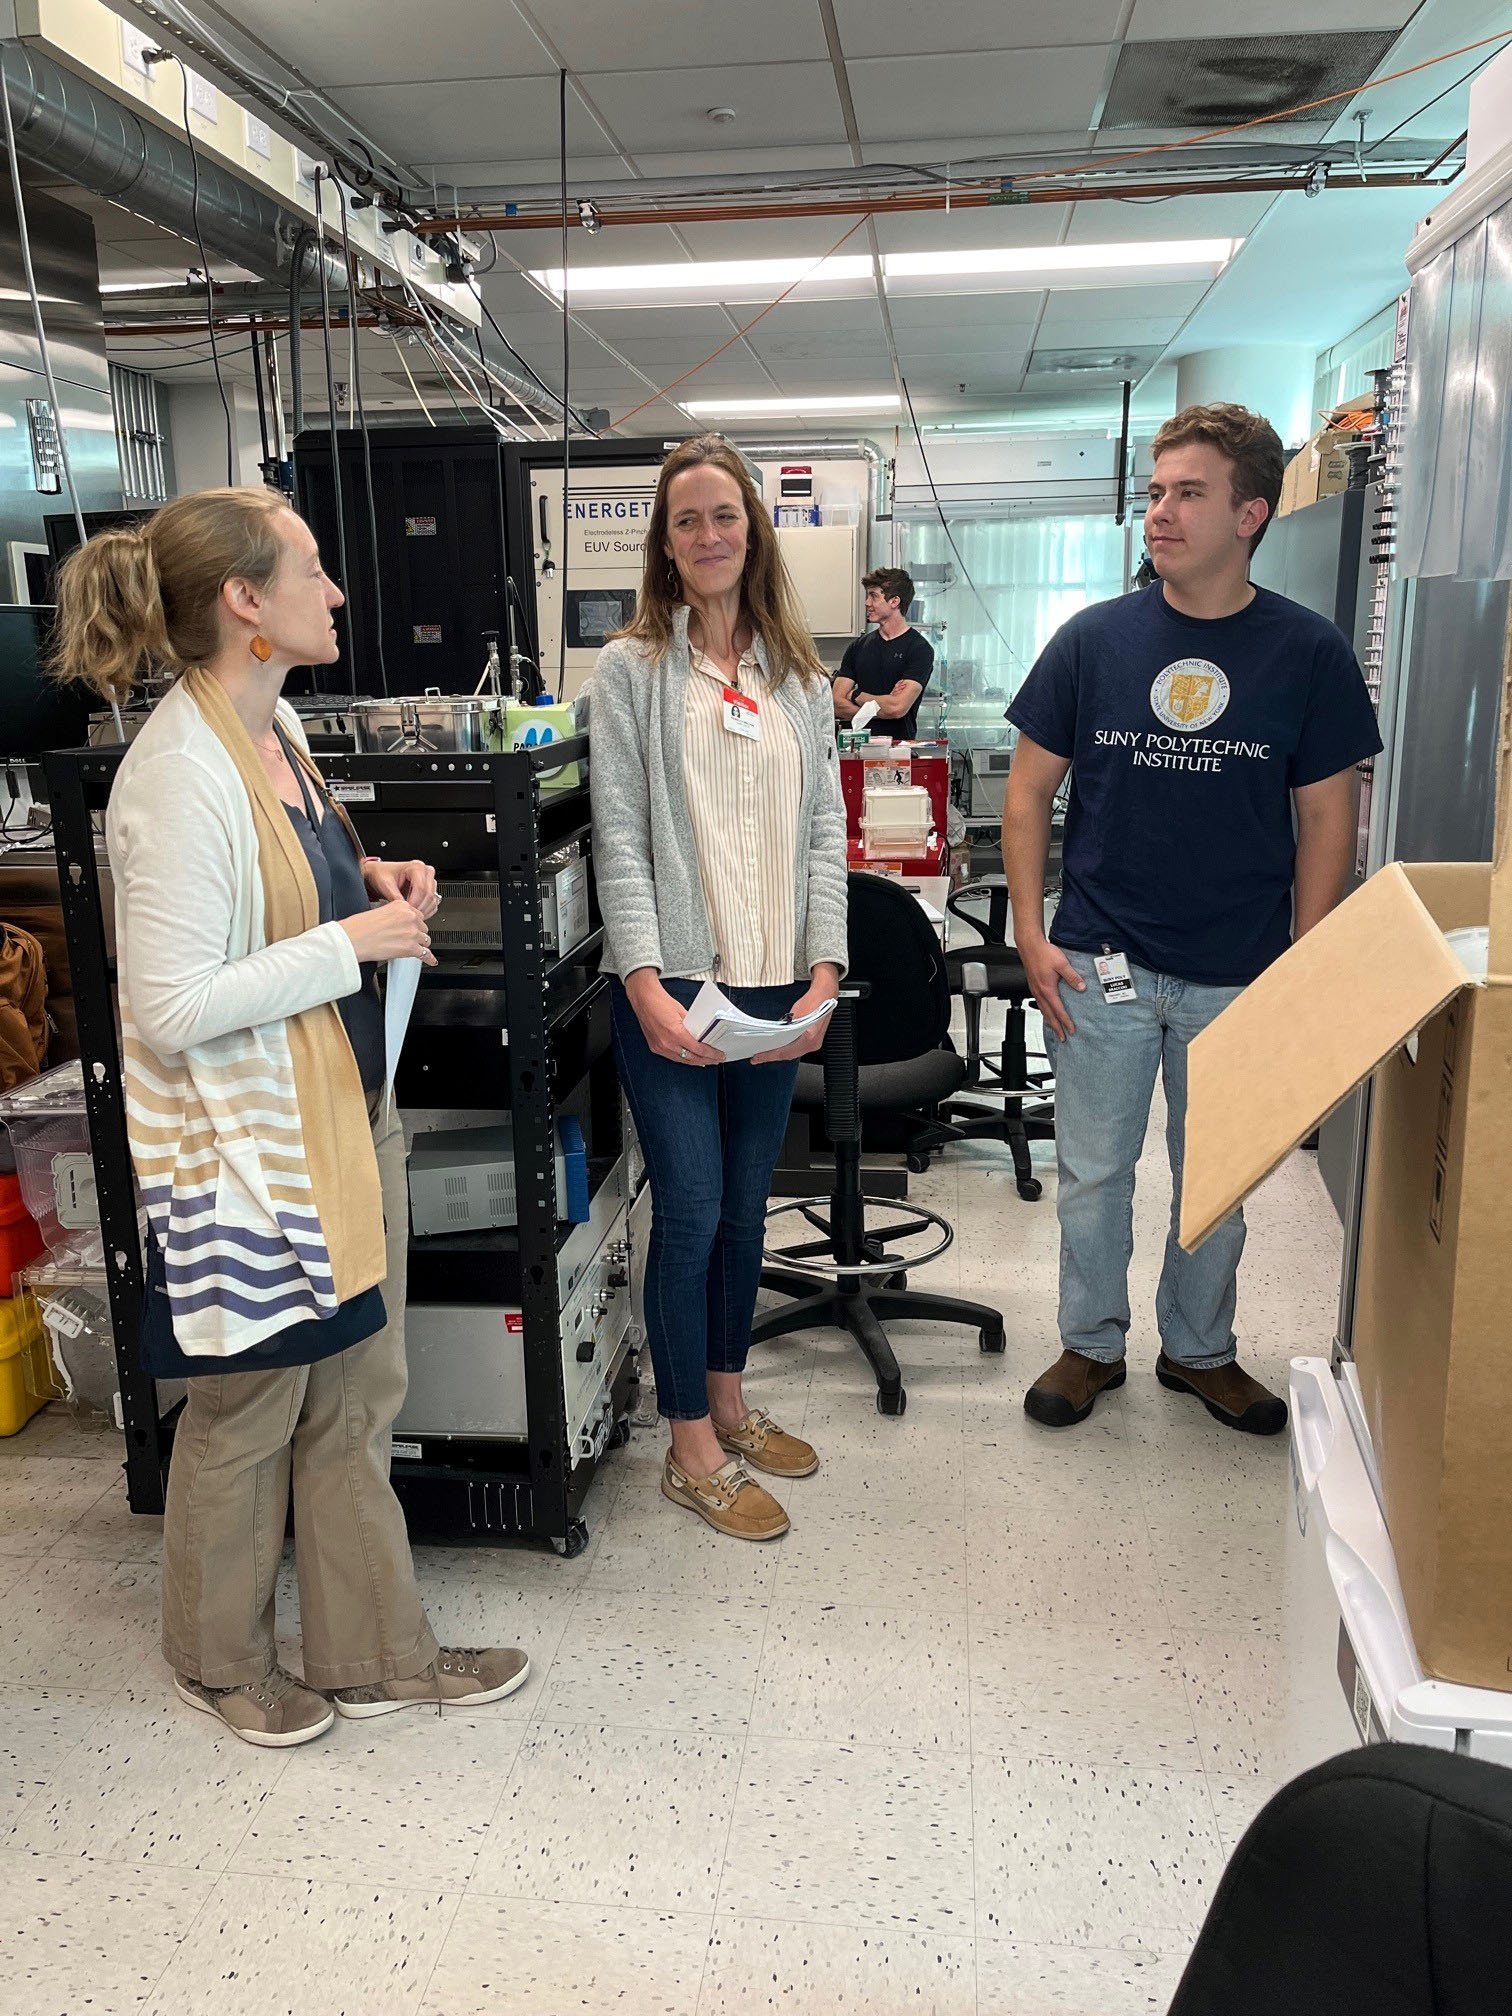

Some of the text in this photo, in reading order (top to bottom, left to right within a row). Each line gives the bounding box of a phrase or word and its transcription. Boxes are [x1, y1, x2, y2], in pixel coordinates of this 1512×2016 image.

[563, 502, 651, 519] ENERGET
[584, 541, 610, 553] EUV
[1156, 660, 1228, 689] POLYTECHNIC INSTITUTE
[1153, 695, 1162, 711] STATE
[1159, 711, 1189, 729] UNIVERSITY
[1199, 716, 1213, 726] NEW
[1212, 702, 1225, 716] YORK
[1094, 730, 1271, 760] SUNY POLYTECHNIC
[1132, 750, 1222, 772] INSTITUTE
